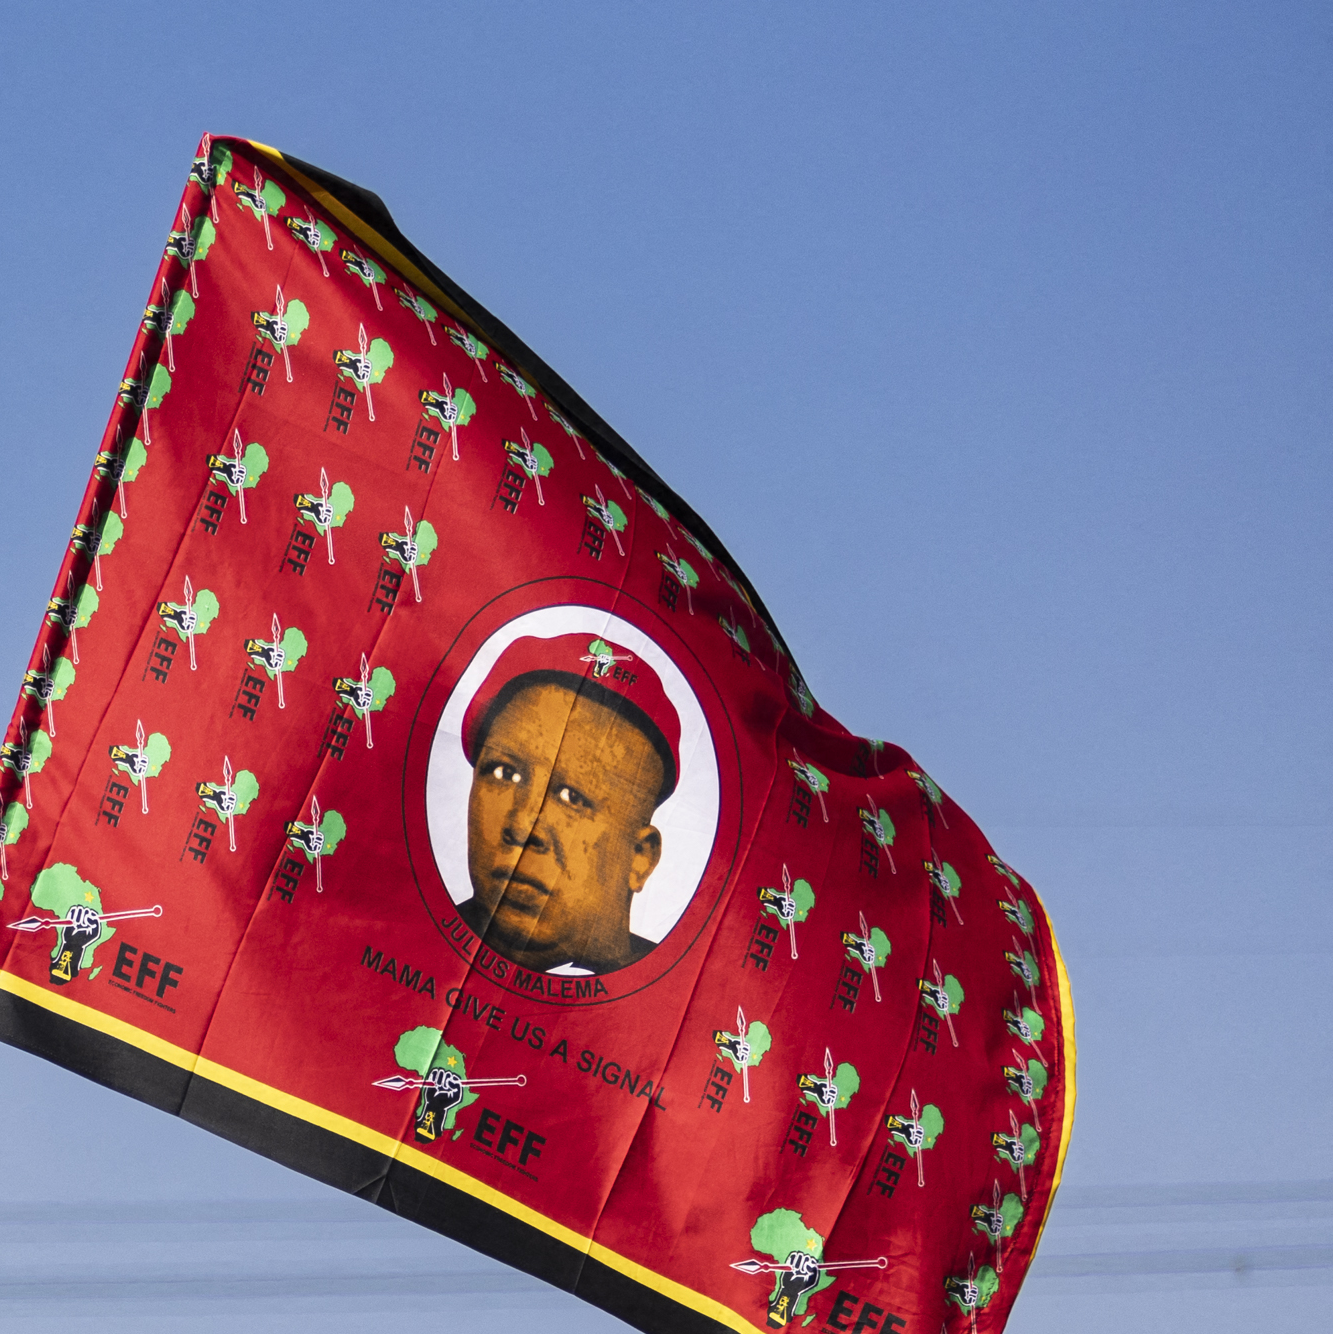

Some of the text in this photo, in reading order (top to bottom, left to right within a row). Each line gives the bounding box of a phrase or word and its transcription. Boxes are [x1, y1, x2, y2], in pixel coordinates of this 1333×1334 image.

[247, 348, 274, 396] EFF
[332, 386, 356, 435] EFF
[413, 425, 440, 474] EFF
[200, 490, 228, 535] EFF
[499, 469, 526, 514] EFF
[287, 530, 316, 576] EFF
[583, 520, 605, 560] EFF
[376, 569, 402, 615] EFF
[665, 575, 680, 613] EFF
[150, 635, 177, 684] EFF
[613, 666, 638, 685] EFF
[237, 674, 265, 722] EFF
[327, 711, 354, 761] EFF
[102, 780, 129, 827] EFF
[793, 785, 812, 829] EFF
[188, 818, 216, 864] EFF
[863, 838, 879, 879] EFF
[276, 857, 305, 904] EFF
[933, 893, 947, 928] EFF
[112, 941, 183, 998] EFF
[441, 916, 608, 998] JULIUS MALEMA
[748, 923, 779, 973] EFF
[838, 966, 863, 1014] EFF
[360, 946, 436, 999] MAMA
[445, 987, 506, 1031] GIVE
[510, 1017, 546, 1050] US
[550, 1040, 569, 1063] A
[576, 1051, 668, 1111] SIGNAL
[920, 1012, 940, 1055] EFF
[710, 1066, 733, 1113] EFF
[473, 1108, 547, 1166] EFF
[788, 1110, 818, 1157] EFF
[875, 1150, 905, 1198] EFF
